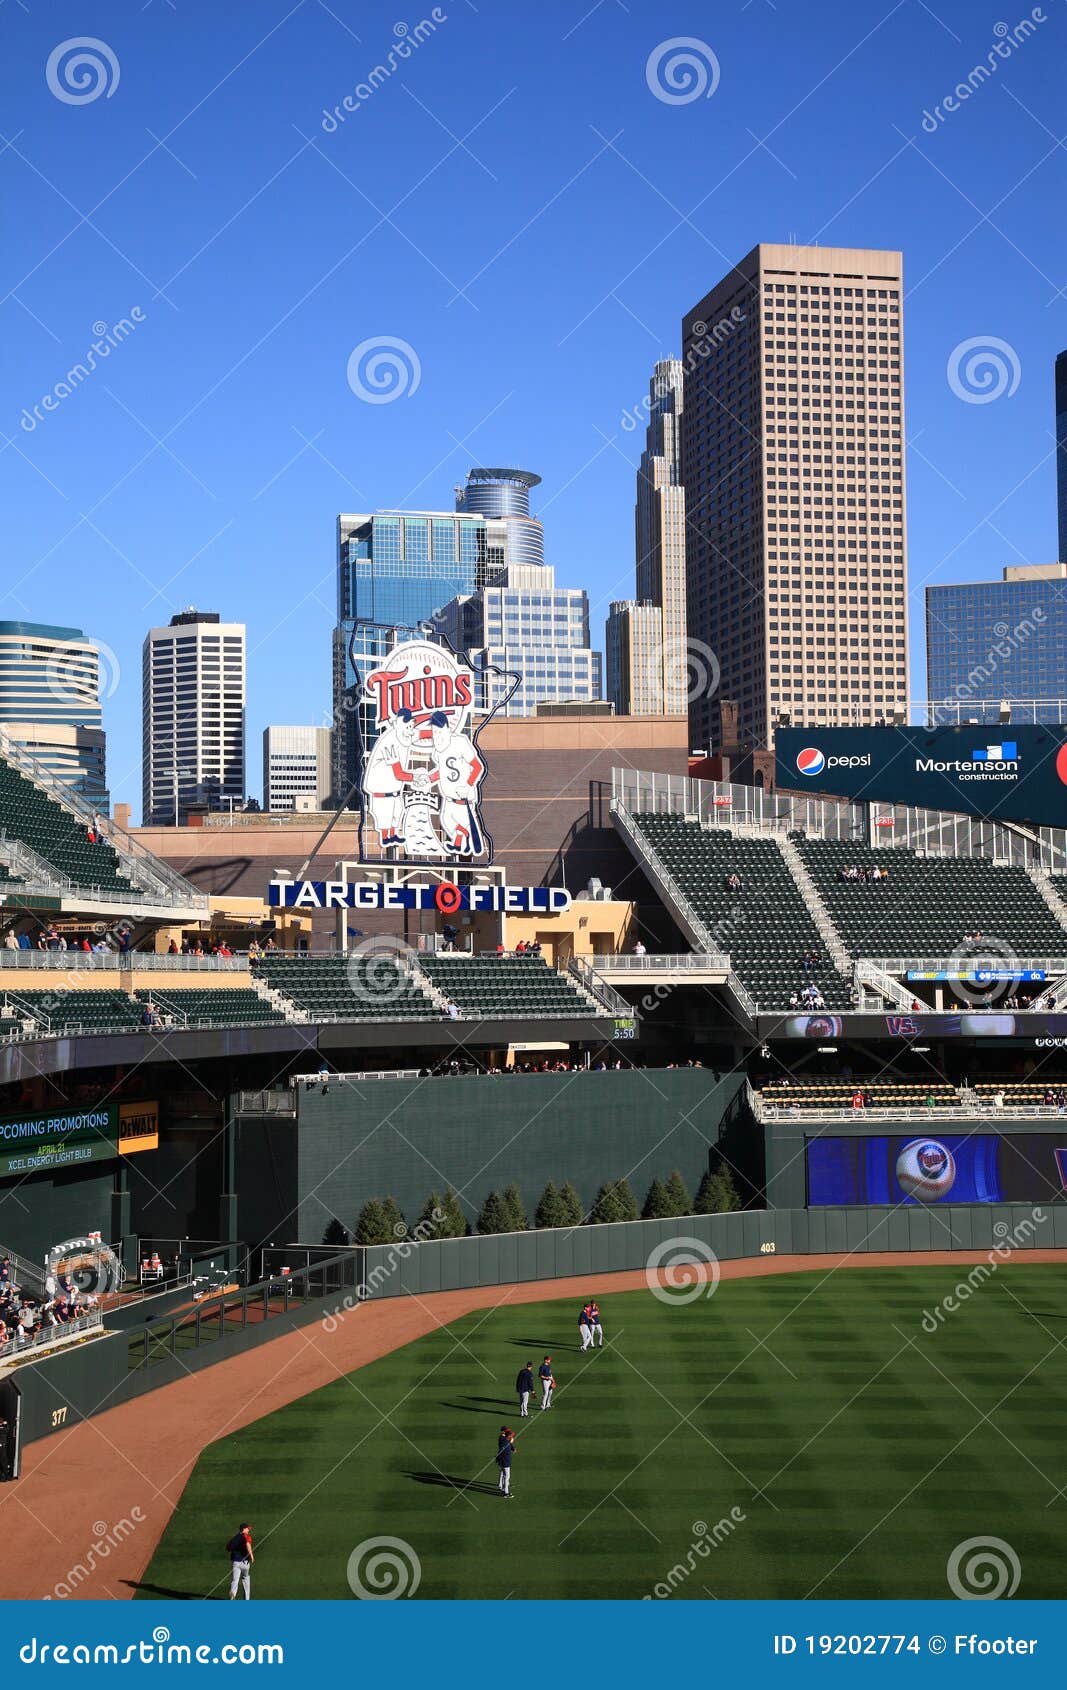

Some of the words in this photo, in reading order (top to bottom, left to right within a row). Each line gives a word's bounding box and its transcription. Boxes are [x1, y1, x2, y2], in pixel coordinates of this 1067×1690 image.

[367, 665, 472, 723] Twins
[827, 753, 871, 768] pepsi
[915, 758, 1018, 772] Mortenson
[958, 772, 1018, 781] construction
[269, 879, 430, 910] TARGET
[469, 885, 573, 912] FIELD
[614, 1019, 633, 1028] TIME
[886, 1016, 917, 1036] VS.
[614, 1028, 635, 1039] 5:50
[47, 1112, 109, 1133] PROMOTIONS
[37, 1145, 56, 1155] APRIL
[8, 1158, 27, 1171] XCEL
[27, 1153, 55, 1168] ENERGY
[55, 1151, 74, 1163] LIGHT
[74, 1148, 92, 1159] BULB
[760, 1242, 776, 1254] 403
[51, 1407, 68, 1426] 377
